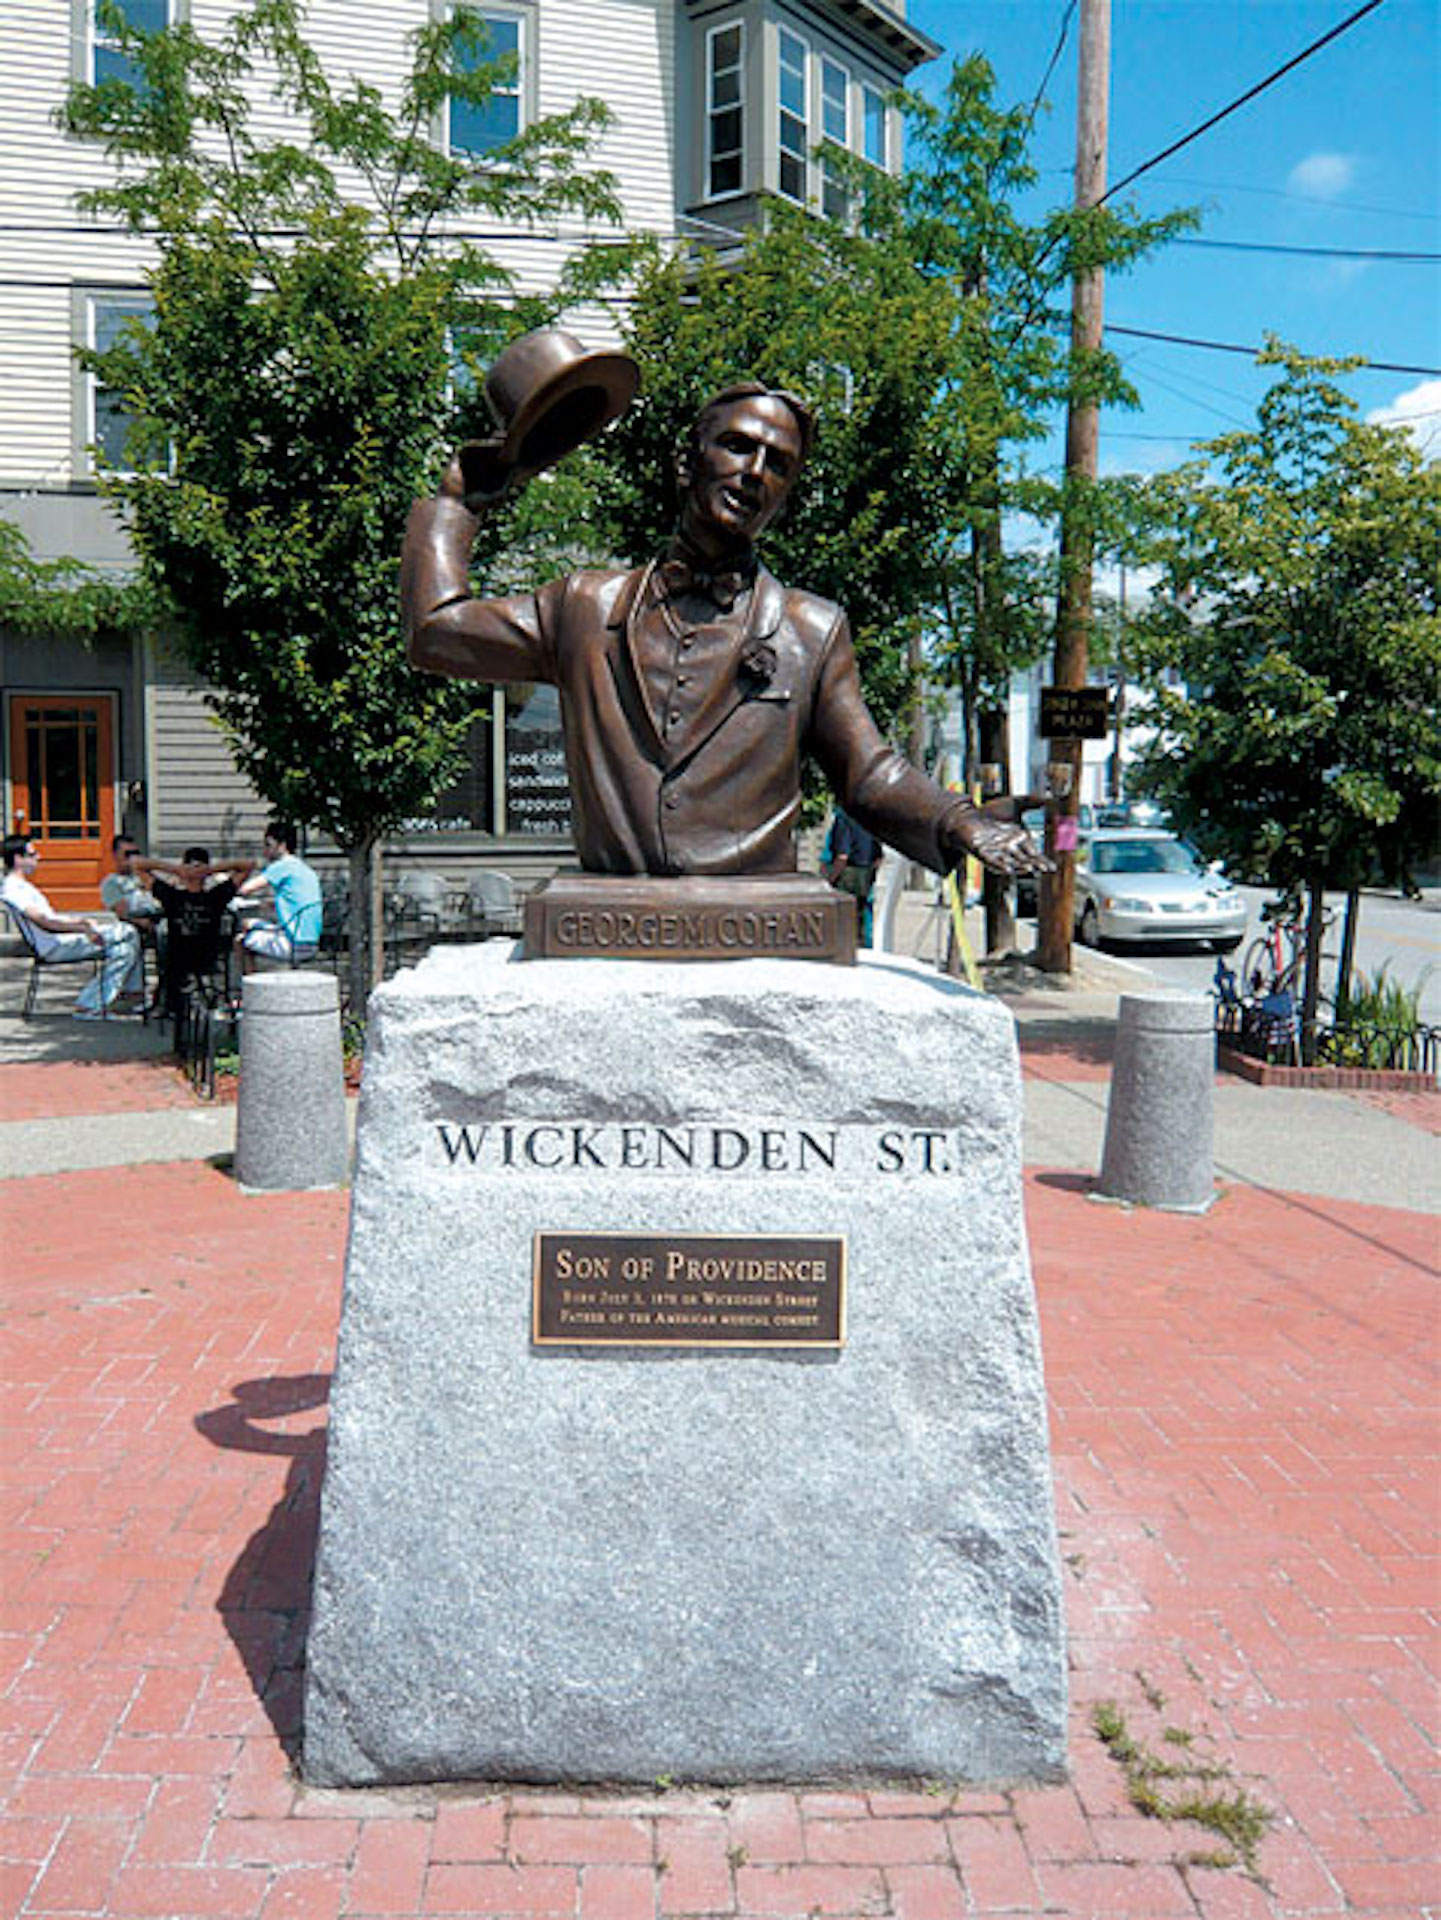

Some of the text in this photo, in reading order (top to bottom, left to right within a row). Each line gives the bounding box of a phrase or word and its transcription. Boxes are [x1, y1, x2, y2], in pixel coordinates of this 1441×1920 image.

[556, 911, 679, 947] GEORGE
[716, 912, 824, 948] COHAN
[438, 1124, 952, 1173] WICKENDEN ST.
[556, 1249, 828, 1282] SON OF PROVIDENCE
